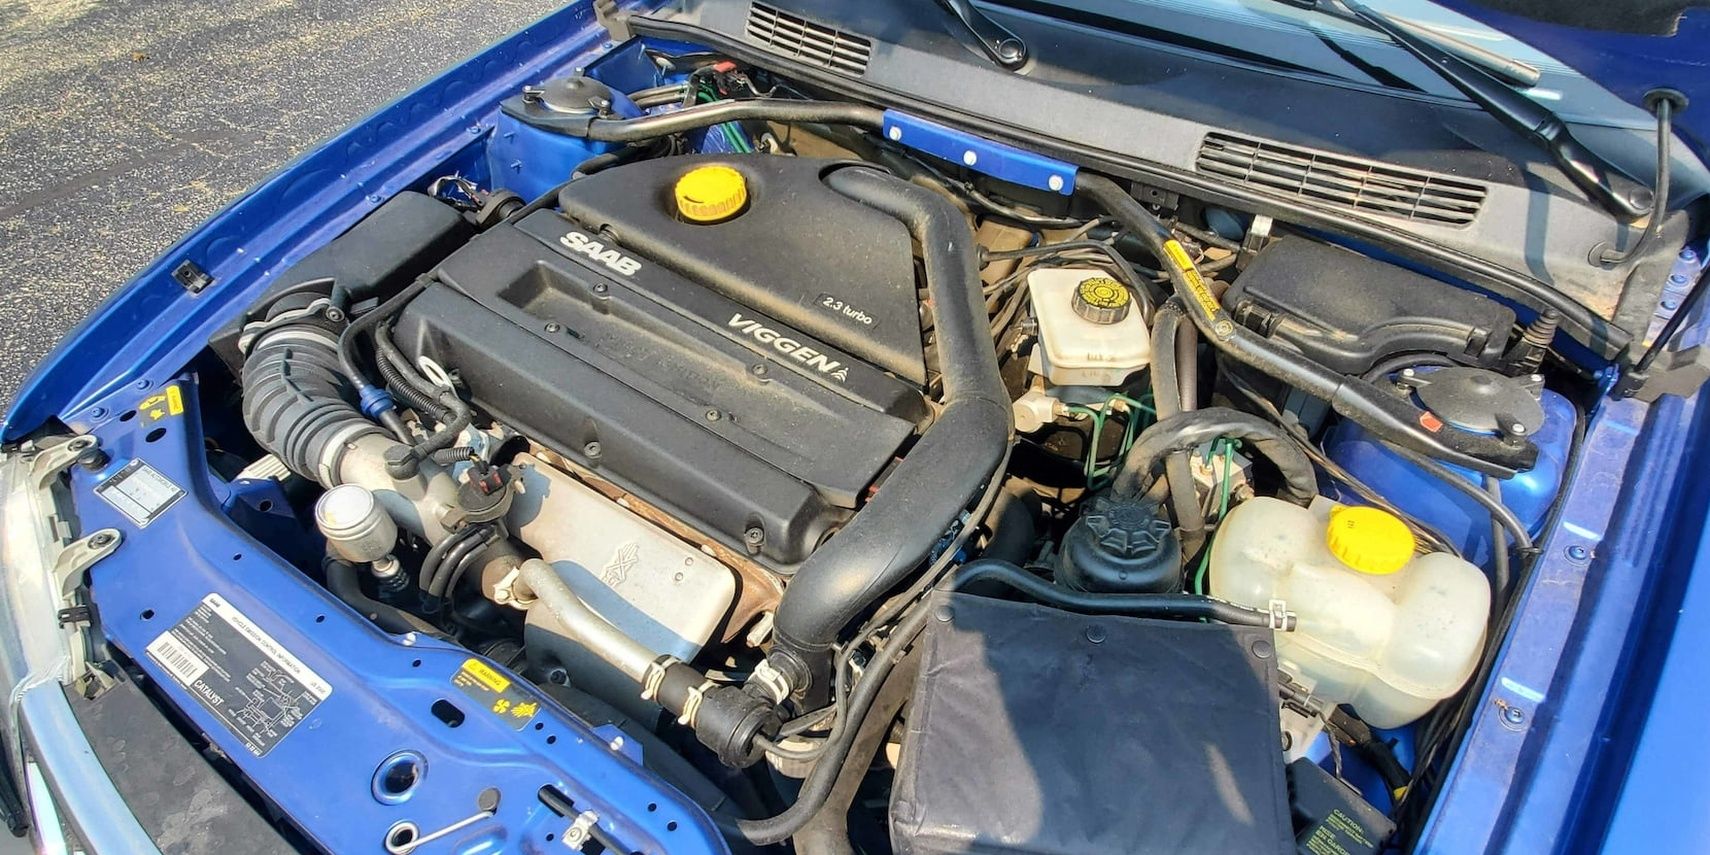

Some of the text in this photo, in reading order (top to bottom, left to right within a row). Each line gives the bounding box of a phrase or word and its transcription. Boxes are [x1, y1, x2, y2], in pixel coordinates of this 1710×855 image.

[560, 231, 642, 276] SAAB
[823, 297, 873, 325] 2.3 turbo
[728, 313, 840, 373] VIGGEN
[194, 679, 225, 706] CATALYST
